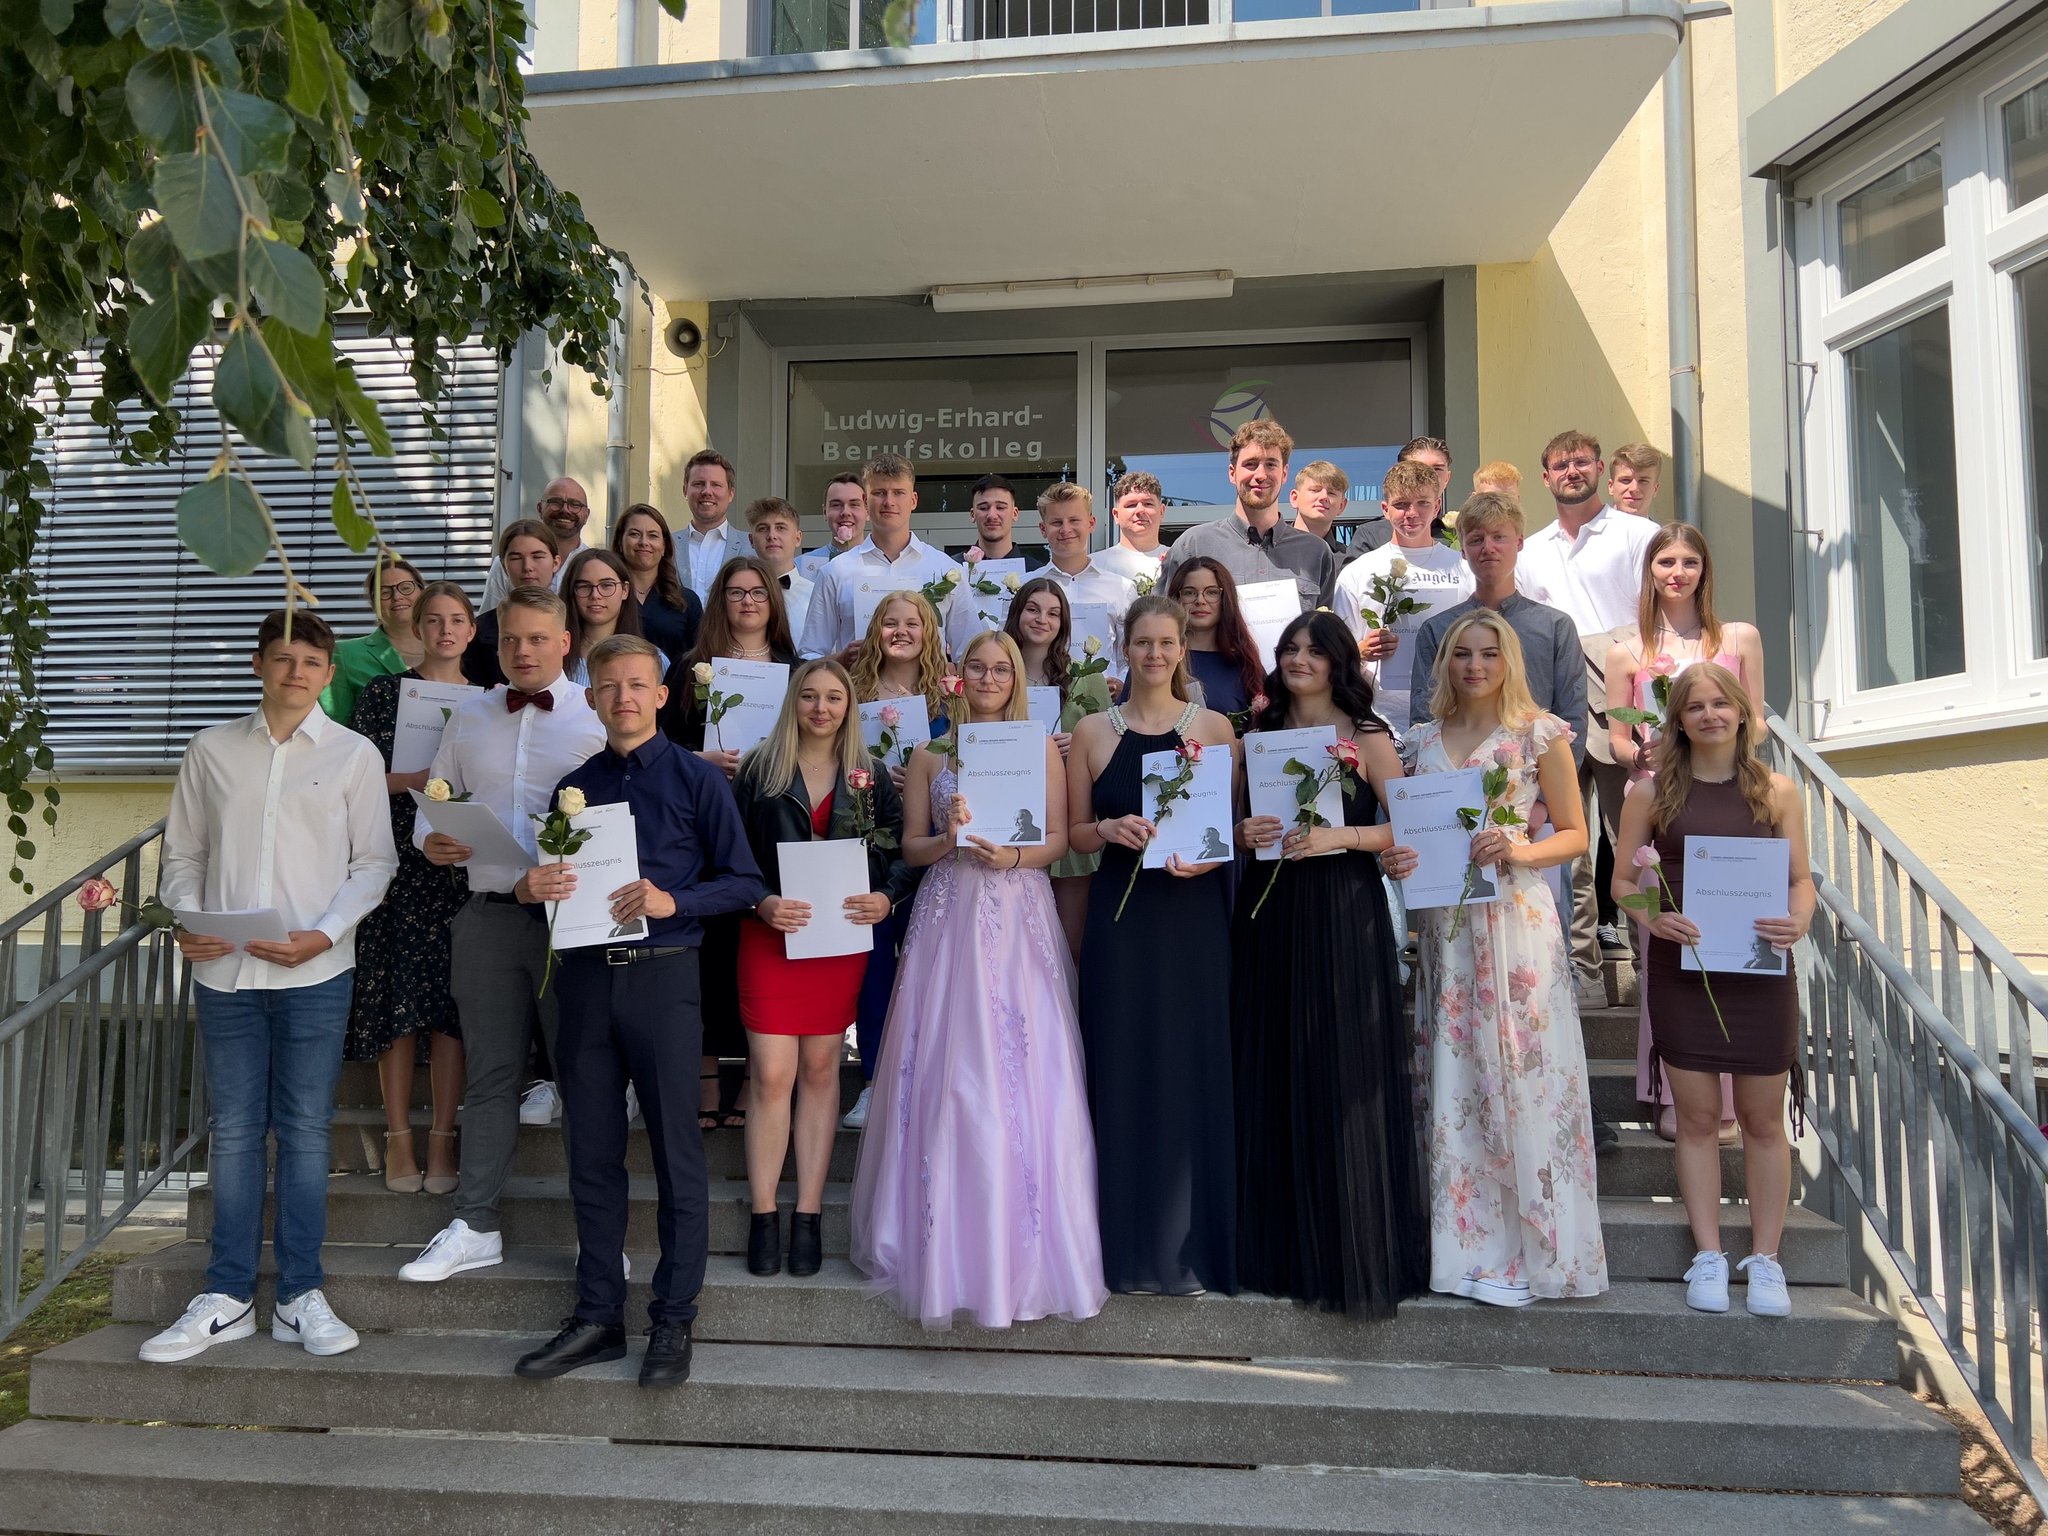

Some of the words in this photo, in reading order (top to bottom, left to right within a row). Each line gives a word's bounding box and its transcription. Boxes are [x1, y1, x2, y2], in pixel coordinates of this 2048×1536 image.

[824, 405, 1043, 433] Ludwig-Erhard-
[823, 437, 1042, 461] Berufskolleg
[1411, 572, 1460, 585] Angels
[967, 768, 1032, 777] Abschlusszeugnis
[1403, 822, 1462, 835] Abschlusszeug
[572, 857, 622, 869] lusszeugnis
[1695, 888, 1772, 898] Abschlusszeugnis
